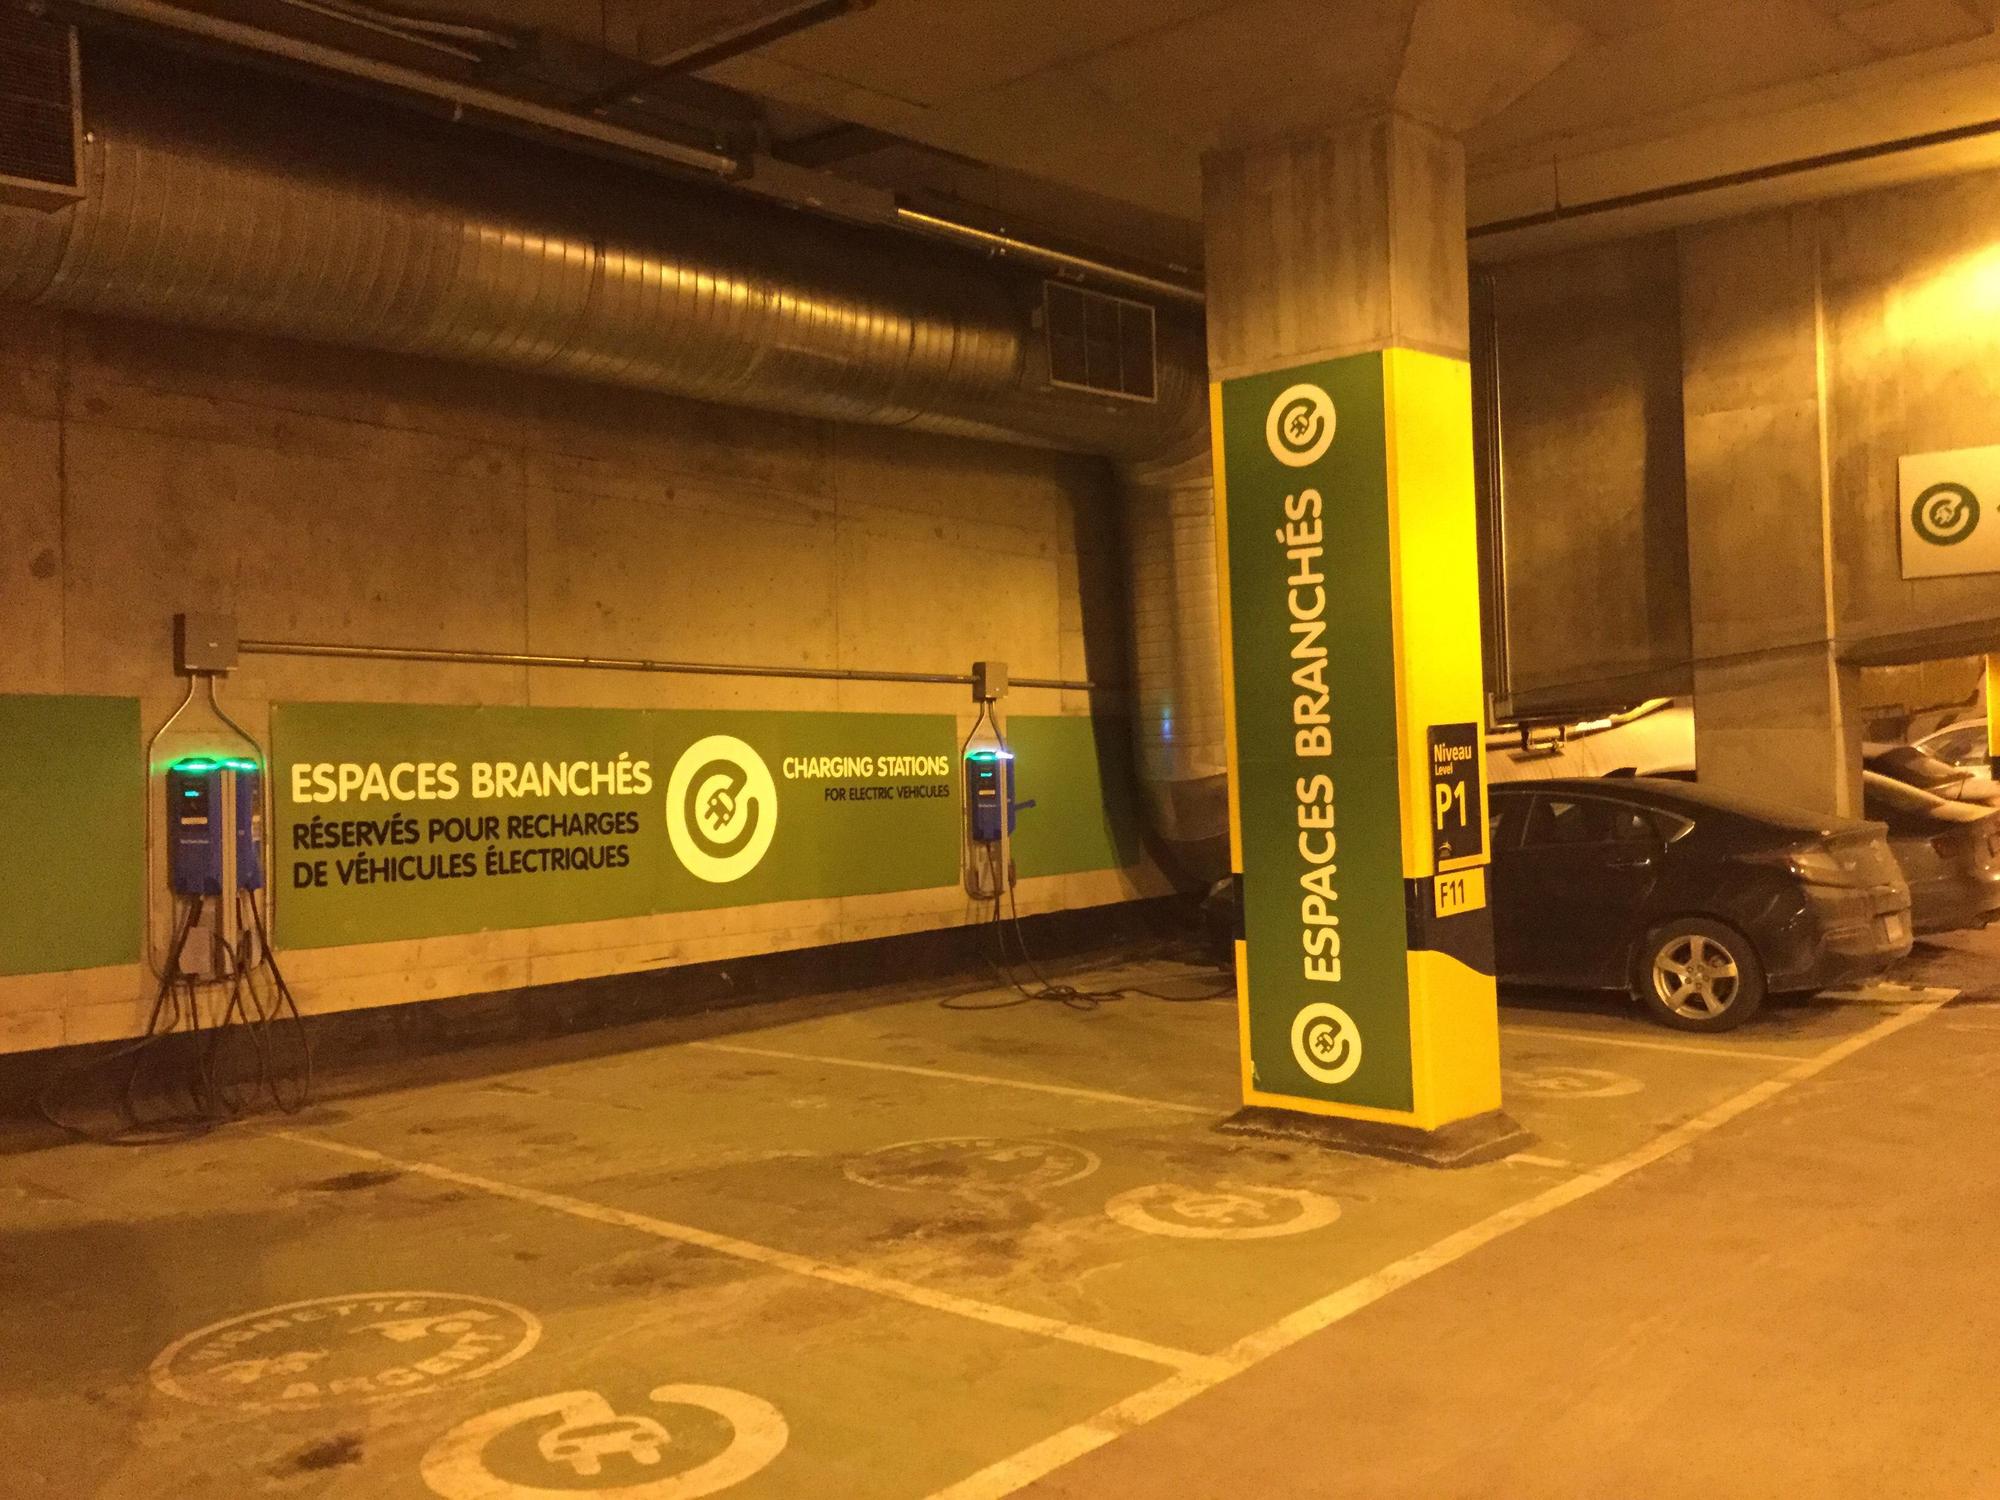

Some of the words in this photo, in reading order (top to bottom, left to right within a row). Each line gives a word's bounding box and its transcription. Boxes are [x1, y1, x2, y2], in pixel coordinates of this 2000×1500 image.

[1276, 488, 1332, 757] BRANCHÉS
[782, 757, 873, 780] CHARGING
[877, 756, 949, 777] STATIONS
[1433, 742, 1472, 762] Niveau
[1434, 762, 1453, 776] Level
[291, 762, 460, 803] ESPACES
[471, 751, 653, 798] BRANCHÉS
[824, 787, 846, 801] FOR
[849, 786, 894, 801] ELECTRIC
[897, 784, 950, 799] VEHICULES
[1435, 780, 1466, 830] P1
[293, 814, 420, 850] RÉSERVÉS
[428, 816, 500, 842] POUR
[507, 811, 640, 840] RECHARGES
[293, 861, 328, 889] DE
[336, 851, 477, 886] VÉHICULES
[485, 845, 630, 876] ÉLECTRIQUES
[1296, 773, 1341, 983] ESPACES
[1440, 878, 1465, 908] F11
